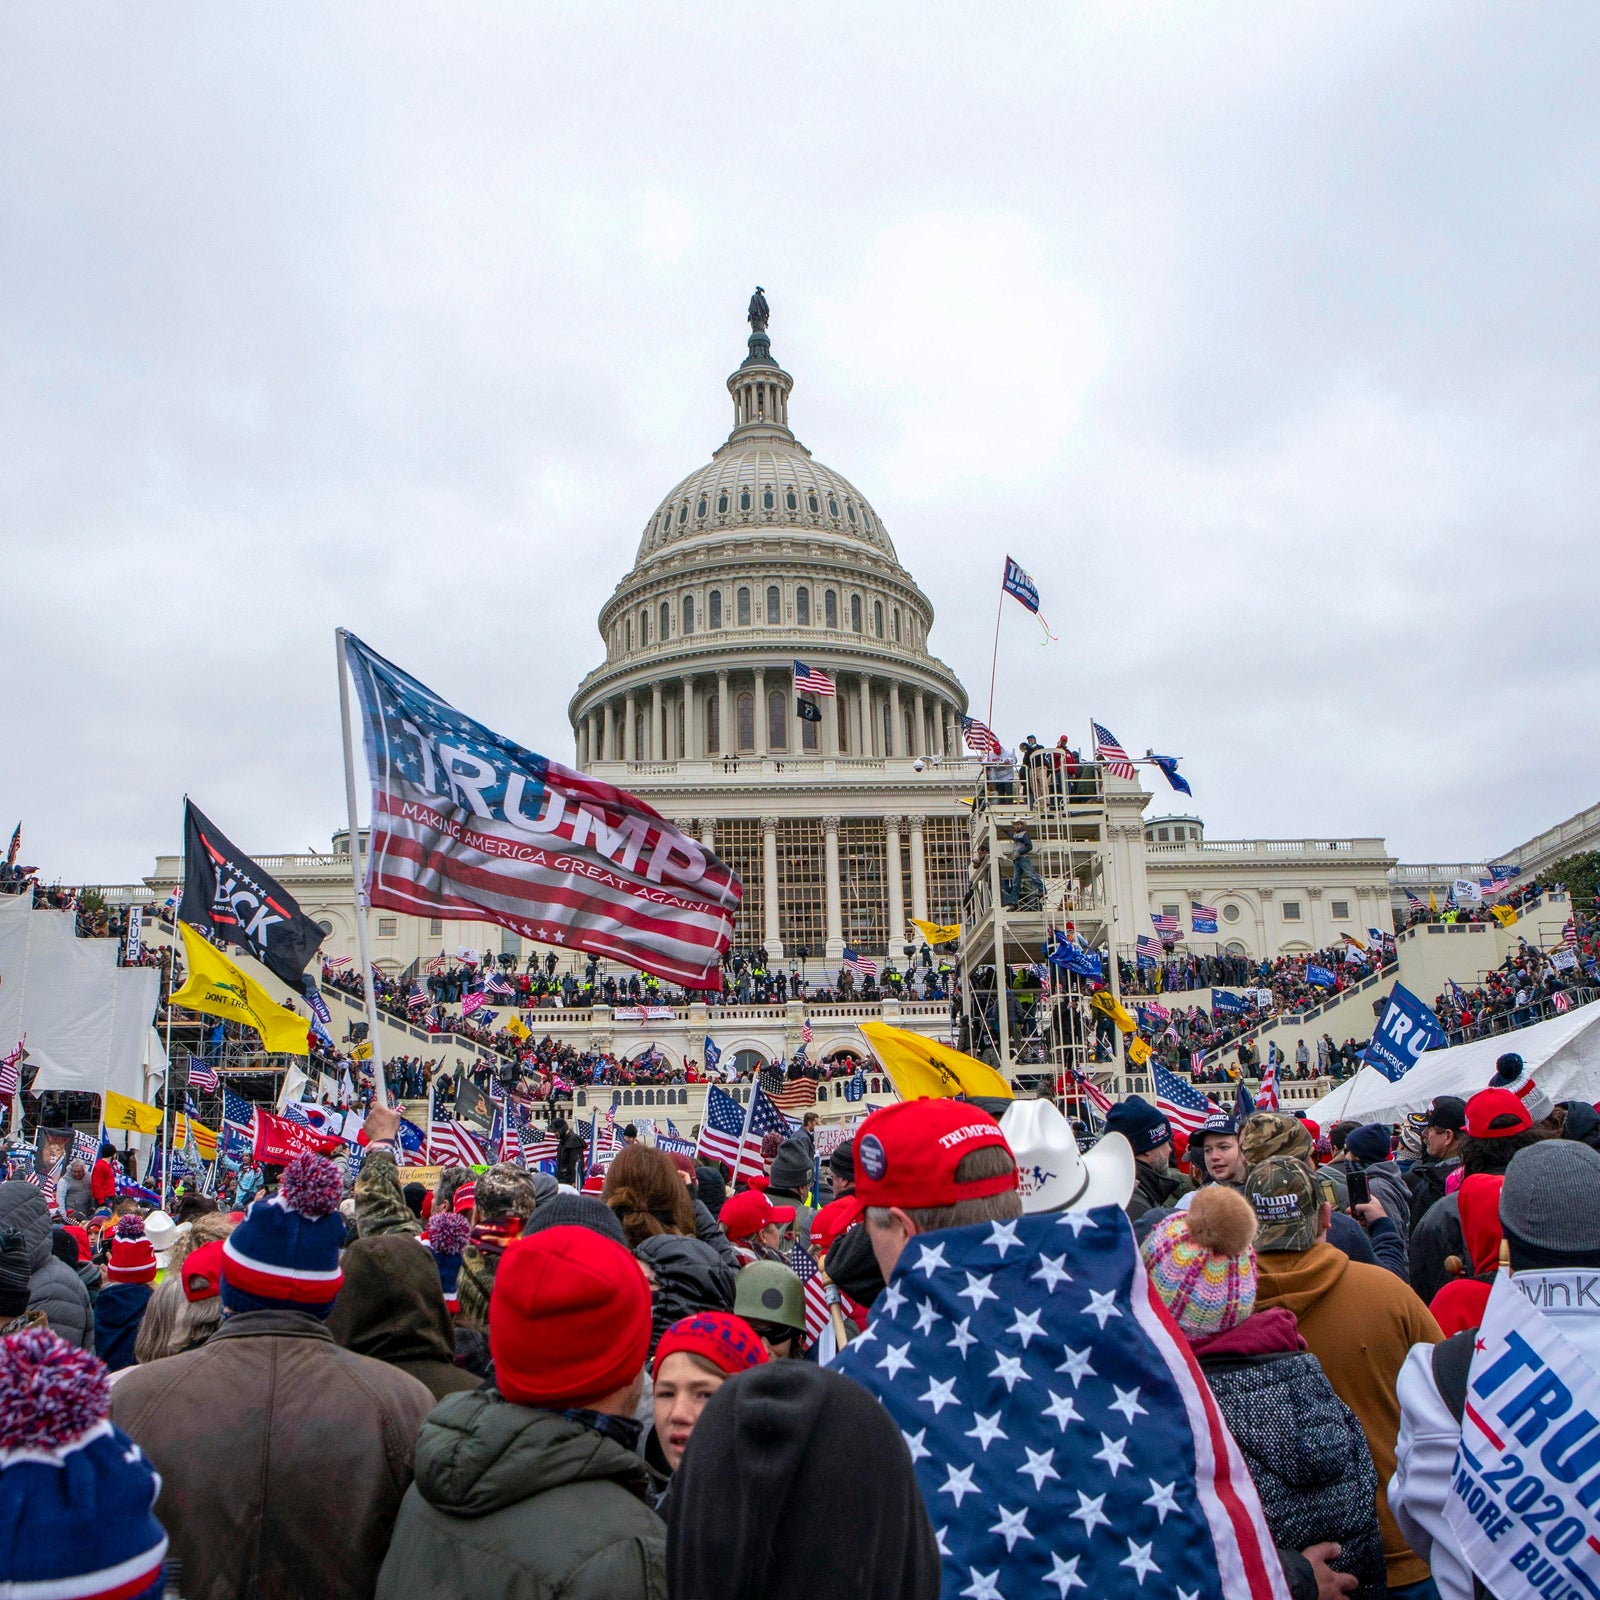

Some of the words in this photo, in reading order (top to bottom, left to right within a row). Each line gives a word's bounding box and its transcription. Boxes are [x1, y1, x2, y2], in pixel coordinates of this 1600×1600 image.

[402, 719, 707, 884] TRUMP
[402, 802, 461, 838] MAKING
[465, 833, 547, 865] AMERICA
[554, 857, 630, 890] GREAT
[634, 887, 710, 913] AGAIN!
[129, 908, 140, 960] TRUMP
[312, 992, 330, 1023] TRUMP
[1215, 1003, 1241, 1012] LIBERTY
[1381, 1001, 1432, 1058] TRU
[74, 1129, 101, 1147] JESUS
[658, 1139, 697, 1157] TRUMP
[1252, 1192, 1298, 1208] Trump
[1519, 1276, 1571, 1307] lvin
[1472, 1329, 1600, 1520] TRU
[1452, 1467, 1515, 1544] MORE
[1480, 1453, 1587, 1557] 2020
